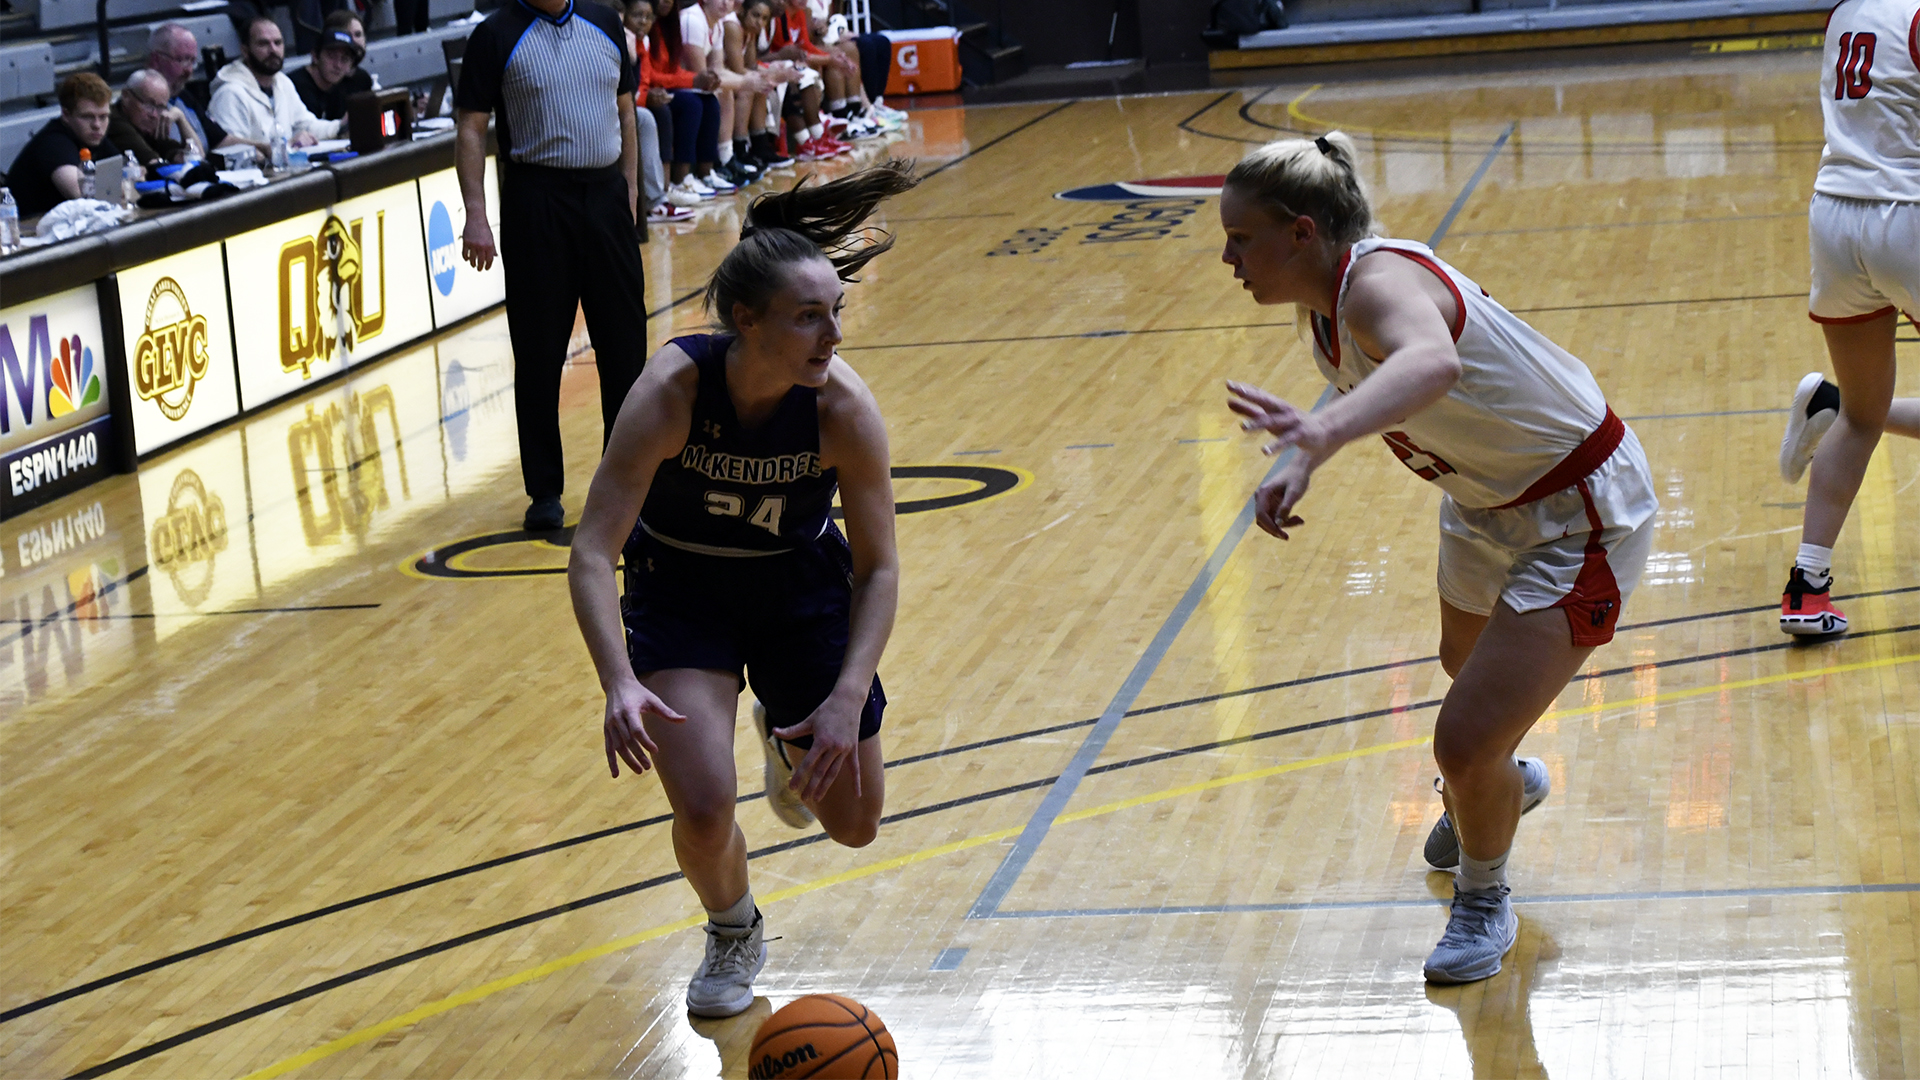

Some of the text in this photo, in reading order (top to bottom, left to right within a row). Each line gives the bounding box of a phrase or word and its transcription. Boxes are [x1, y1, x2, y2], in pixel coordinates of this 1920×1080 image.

[897, 45, 918, 70] G
[1835, 31, 1877, 100] 10
[278, 210, 386, 380] QU
[133, 314, 210, 402] GLVC
[9, 431, 98, 497] ESPN1440
[704, 490, 787, 537] 24
